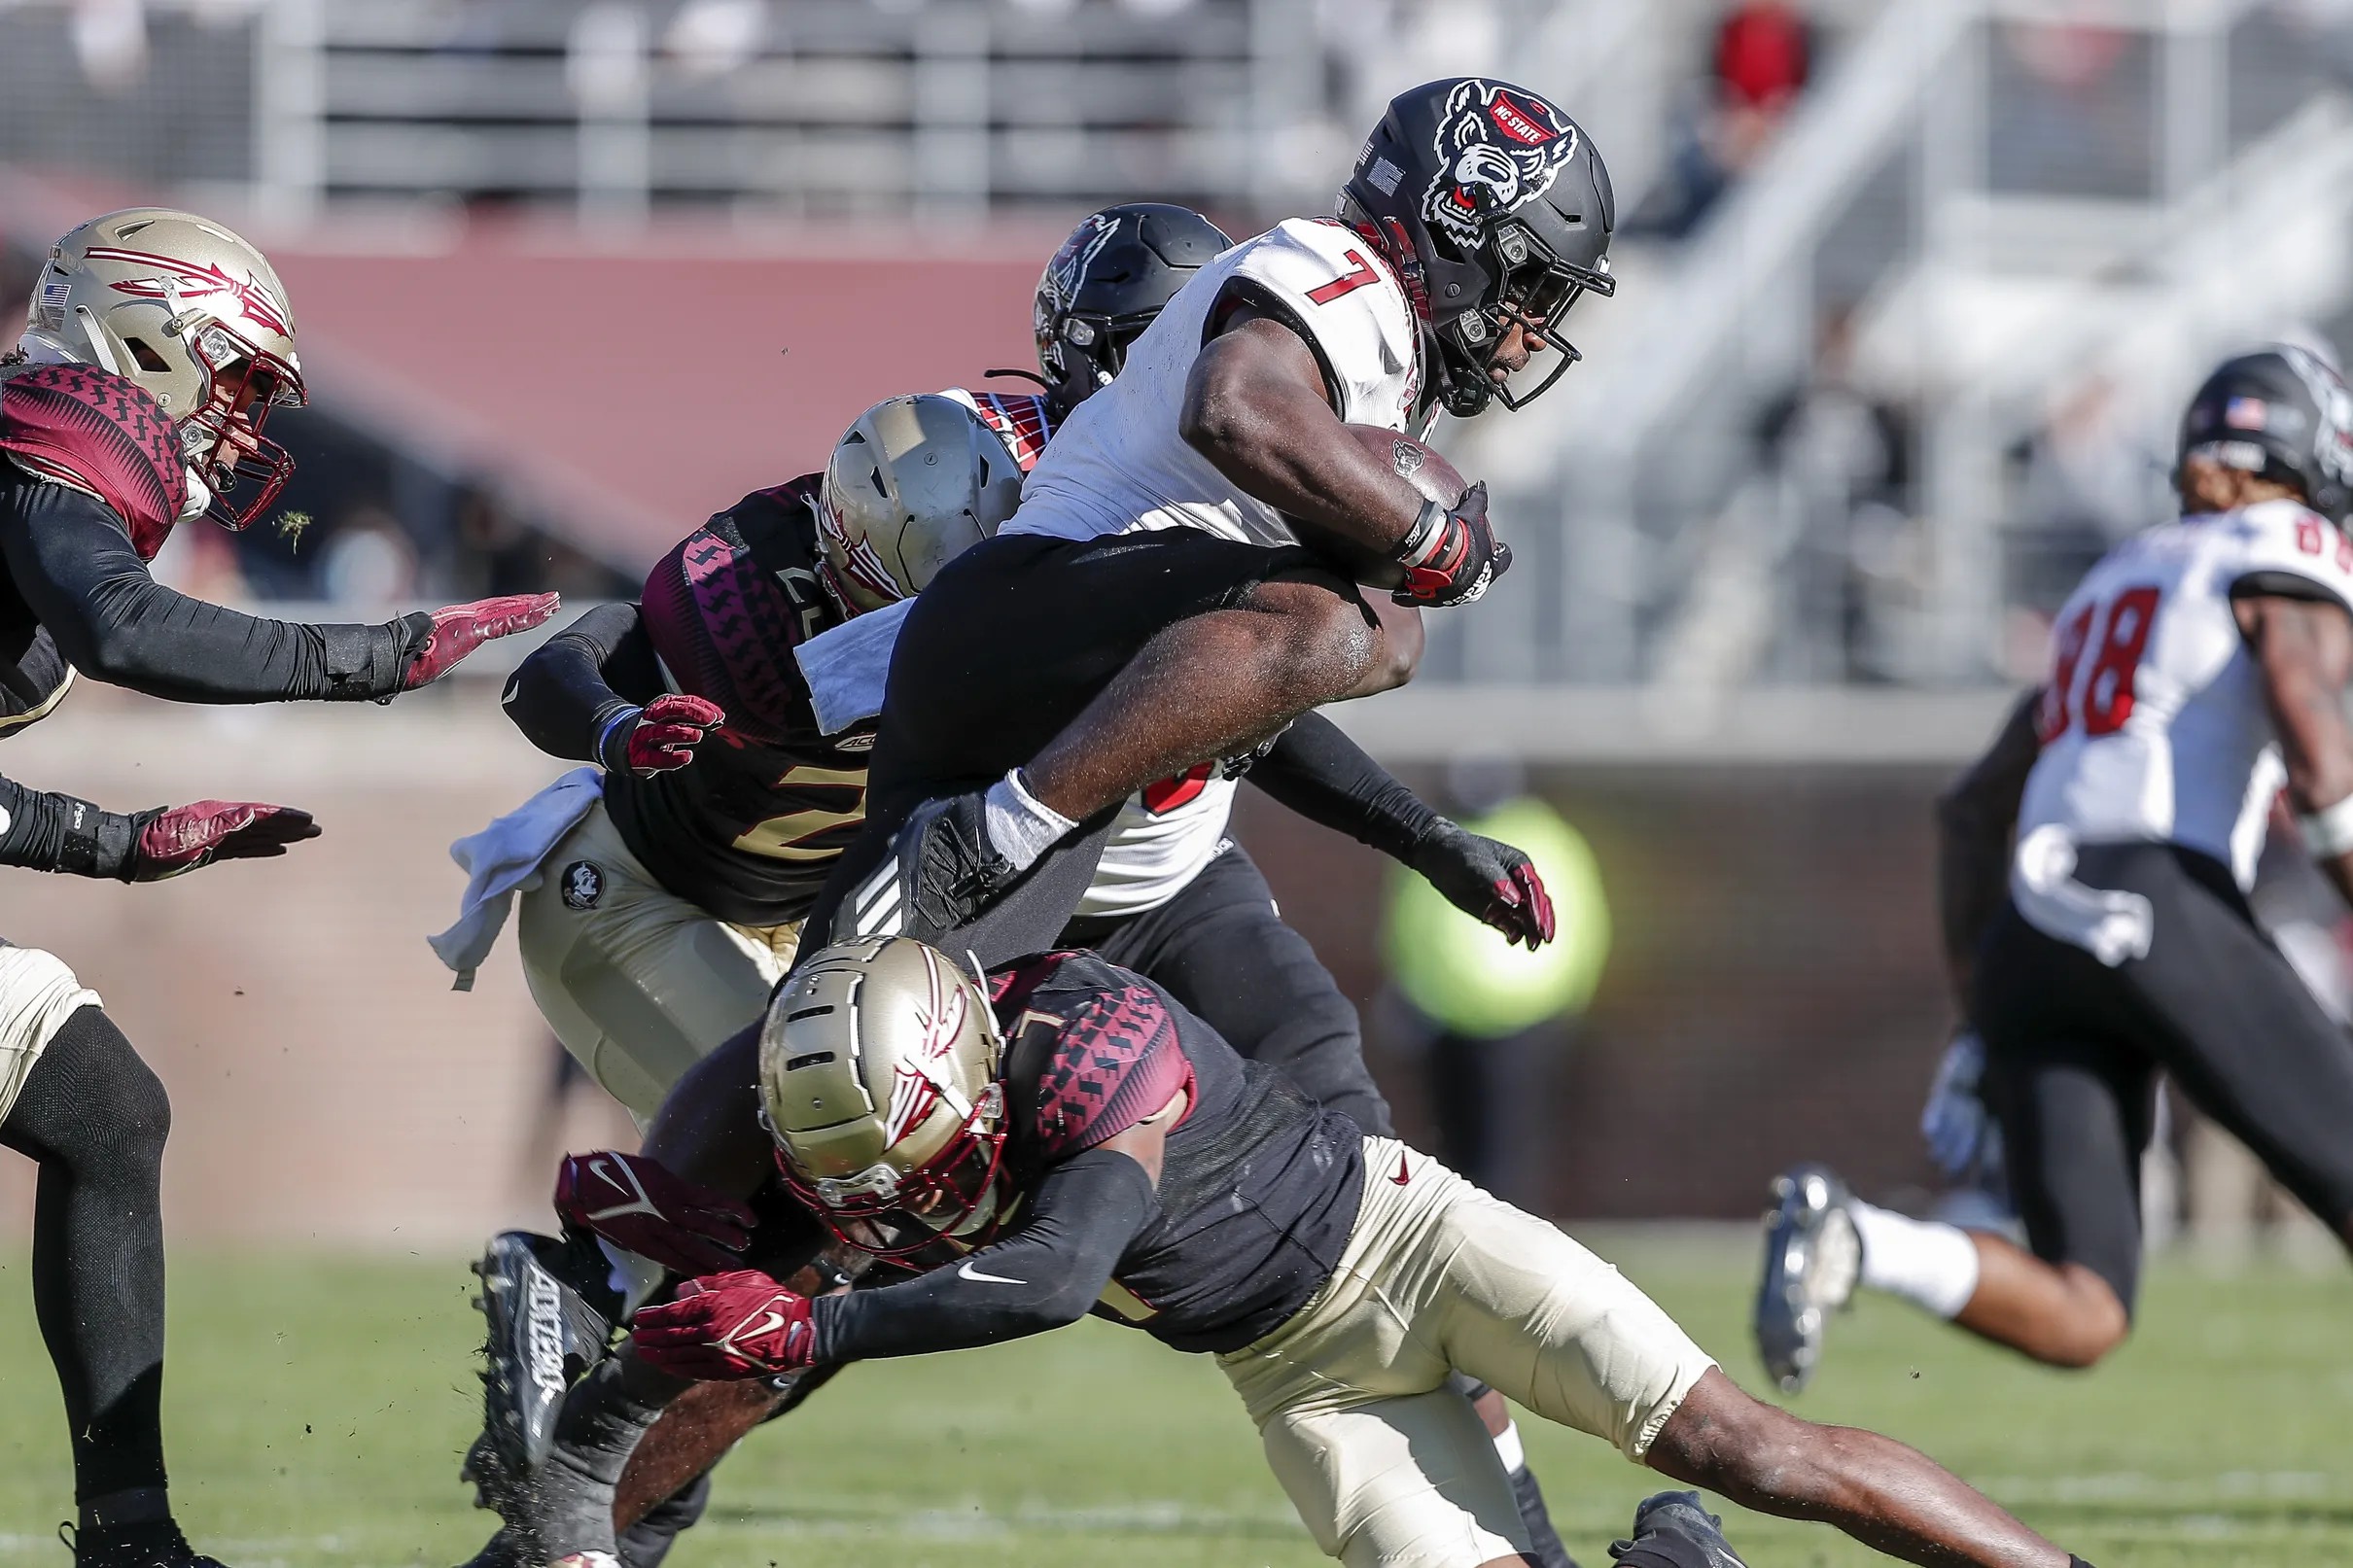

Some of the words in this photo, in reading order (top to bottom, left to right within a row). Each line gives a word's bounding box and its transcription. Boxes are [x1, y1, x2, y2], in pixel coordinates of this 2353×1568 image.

[1493, 105, 1513, 121] NC
[1507, 117, 1542, 143] STATE
[1304, 248, 1382, 306] 7
[2032, 585, 2161, 748] 88
